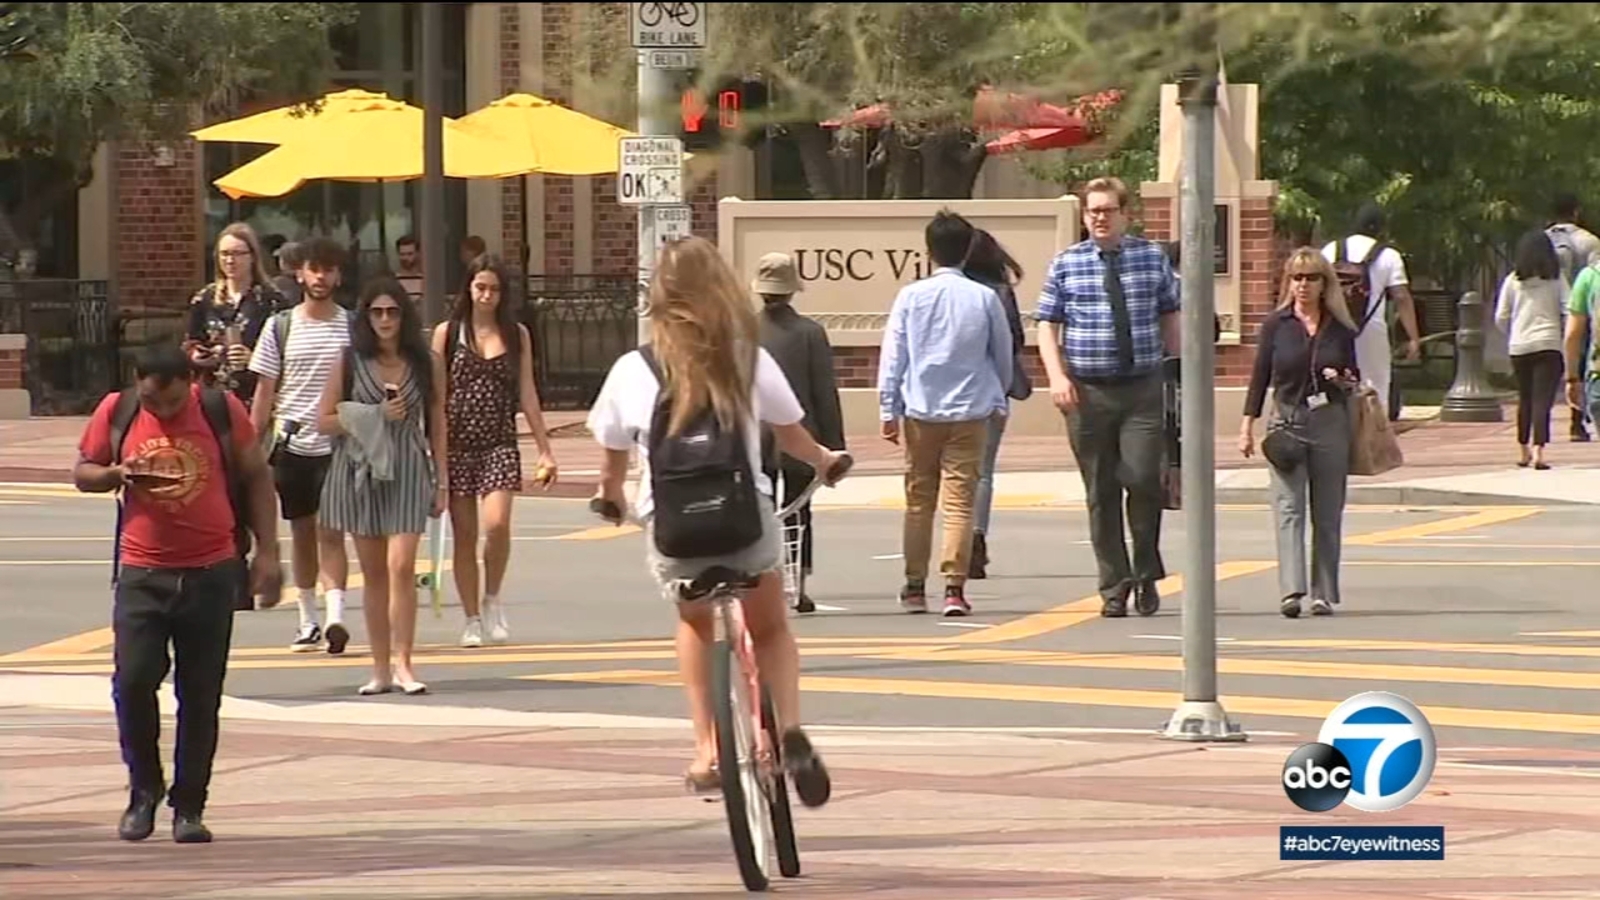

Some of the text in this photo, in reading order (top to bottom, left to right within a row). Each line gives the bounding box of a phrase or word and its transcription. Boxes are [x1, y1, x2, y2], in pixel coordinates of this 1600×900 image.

[640, 31, 698, 45] BIKE LANE
[624, 140, 676, 153] DIAGONAL
[624, 154, 678, 166] CROSSING
[622, 172, 646, 198] OK
[657, 209, 687, 221] CROSS
[795, 249, 874, 281] USC
